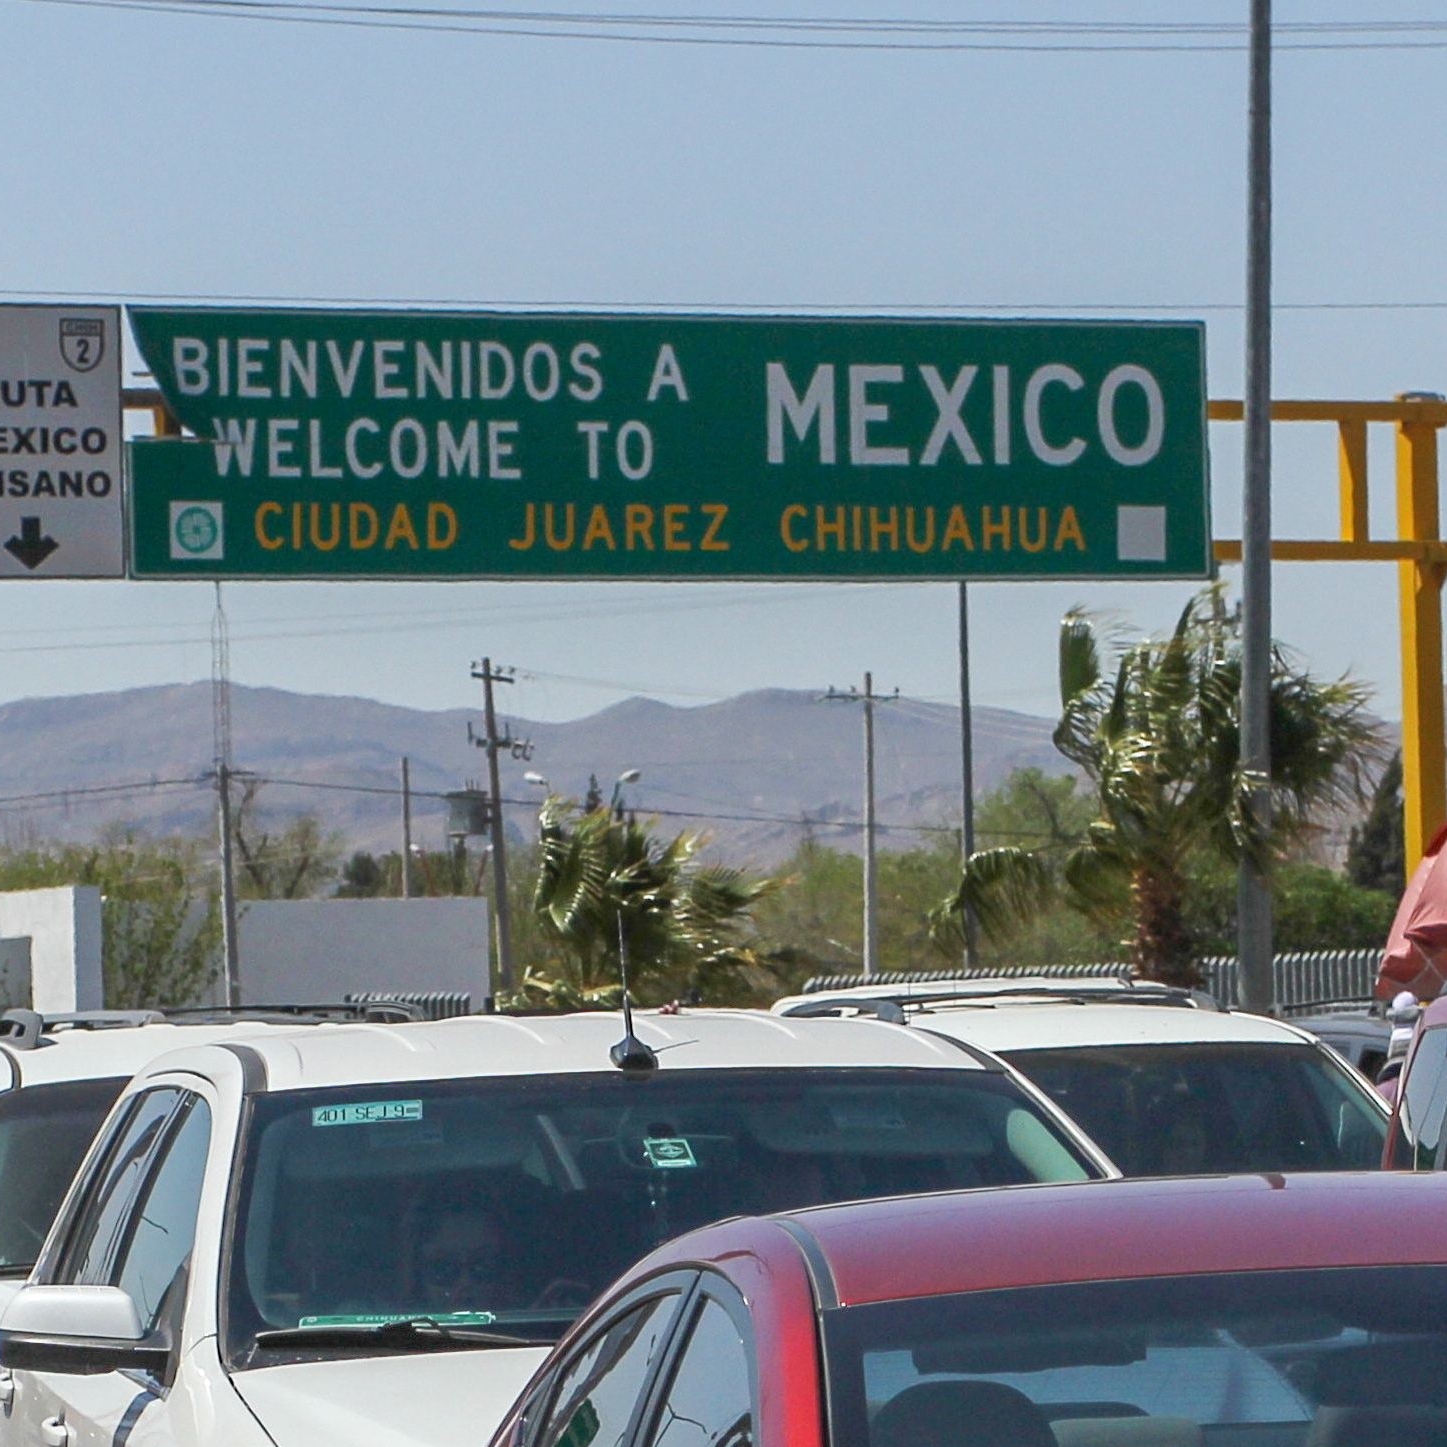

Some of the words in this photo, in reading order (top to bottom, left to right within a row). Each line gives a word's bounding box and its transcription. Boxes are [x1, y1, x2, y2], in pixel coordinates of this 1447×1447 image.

[76, 339, 89, 363] 2
[172, 337, 603, 401] BIENVENIDOS
[647, 344, 689, 401] A
[766, 363, 1165, 466] MEXICO
[212, 417, 522, 479] WELCOME
[577, 420, 653, 480] TO
[255, 501, 458, 550] CIUDAD
[509, 503, 730, 551] JUAREZ
[780, 503, 1086, 554] CHIHUAHUA
